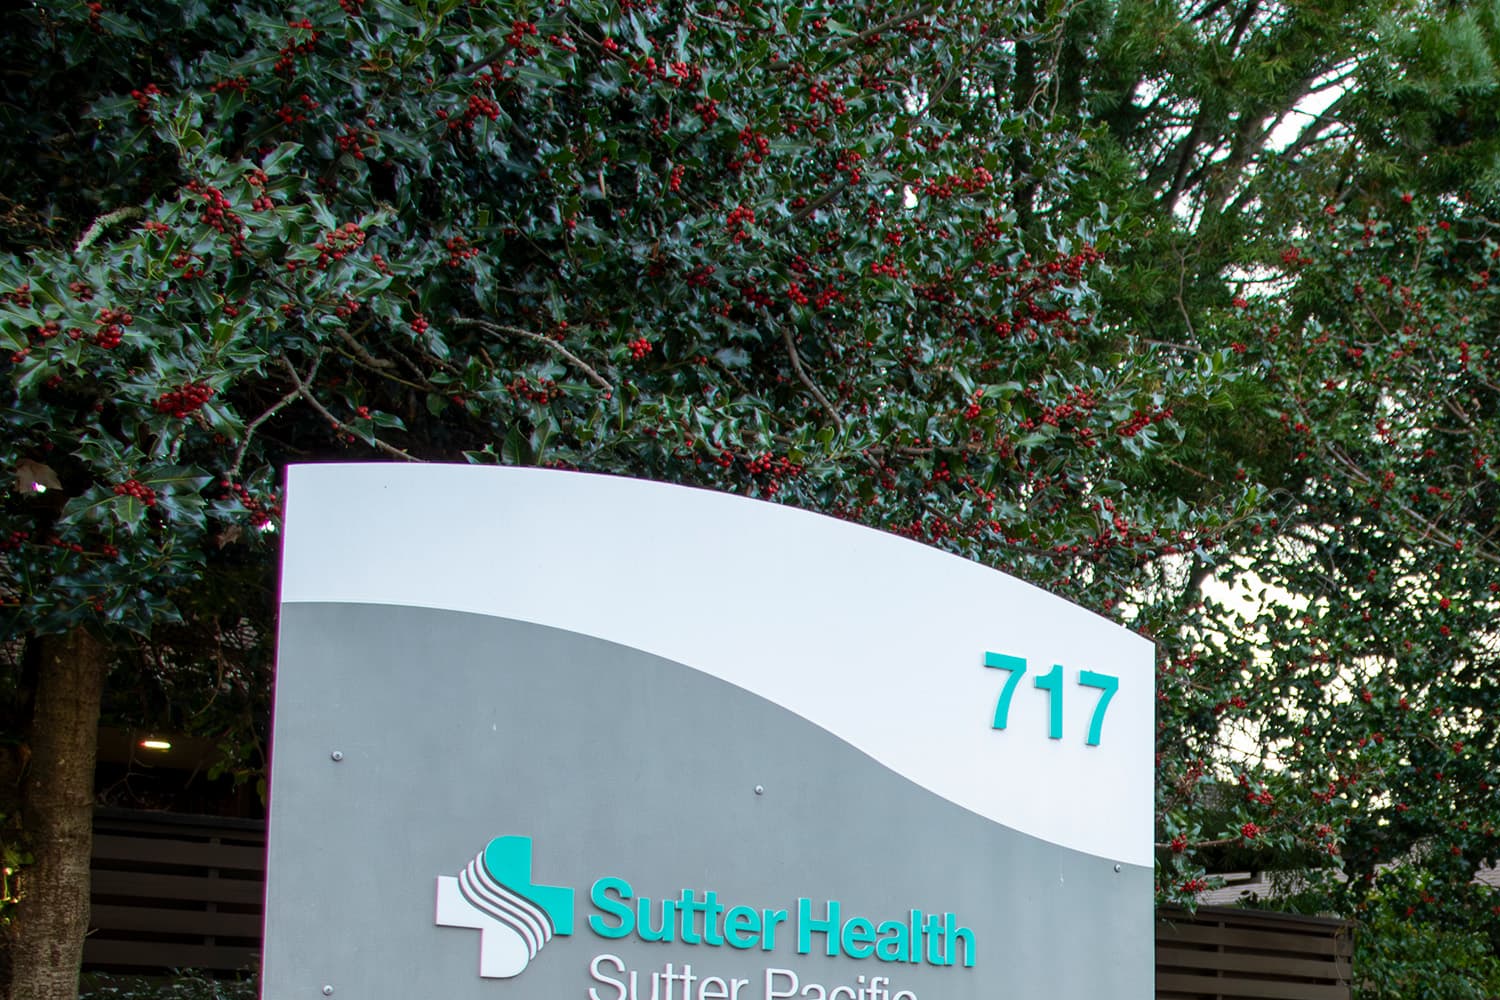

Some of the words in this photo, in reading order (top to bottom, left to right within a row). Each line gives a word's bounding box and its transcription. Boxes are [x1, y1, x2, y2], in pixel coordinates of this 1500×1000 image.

[983, 651, 1119, 746] 717
[589, 876, 788, 951] Sutter
[798, 897, 977, 967] Health
